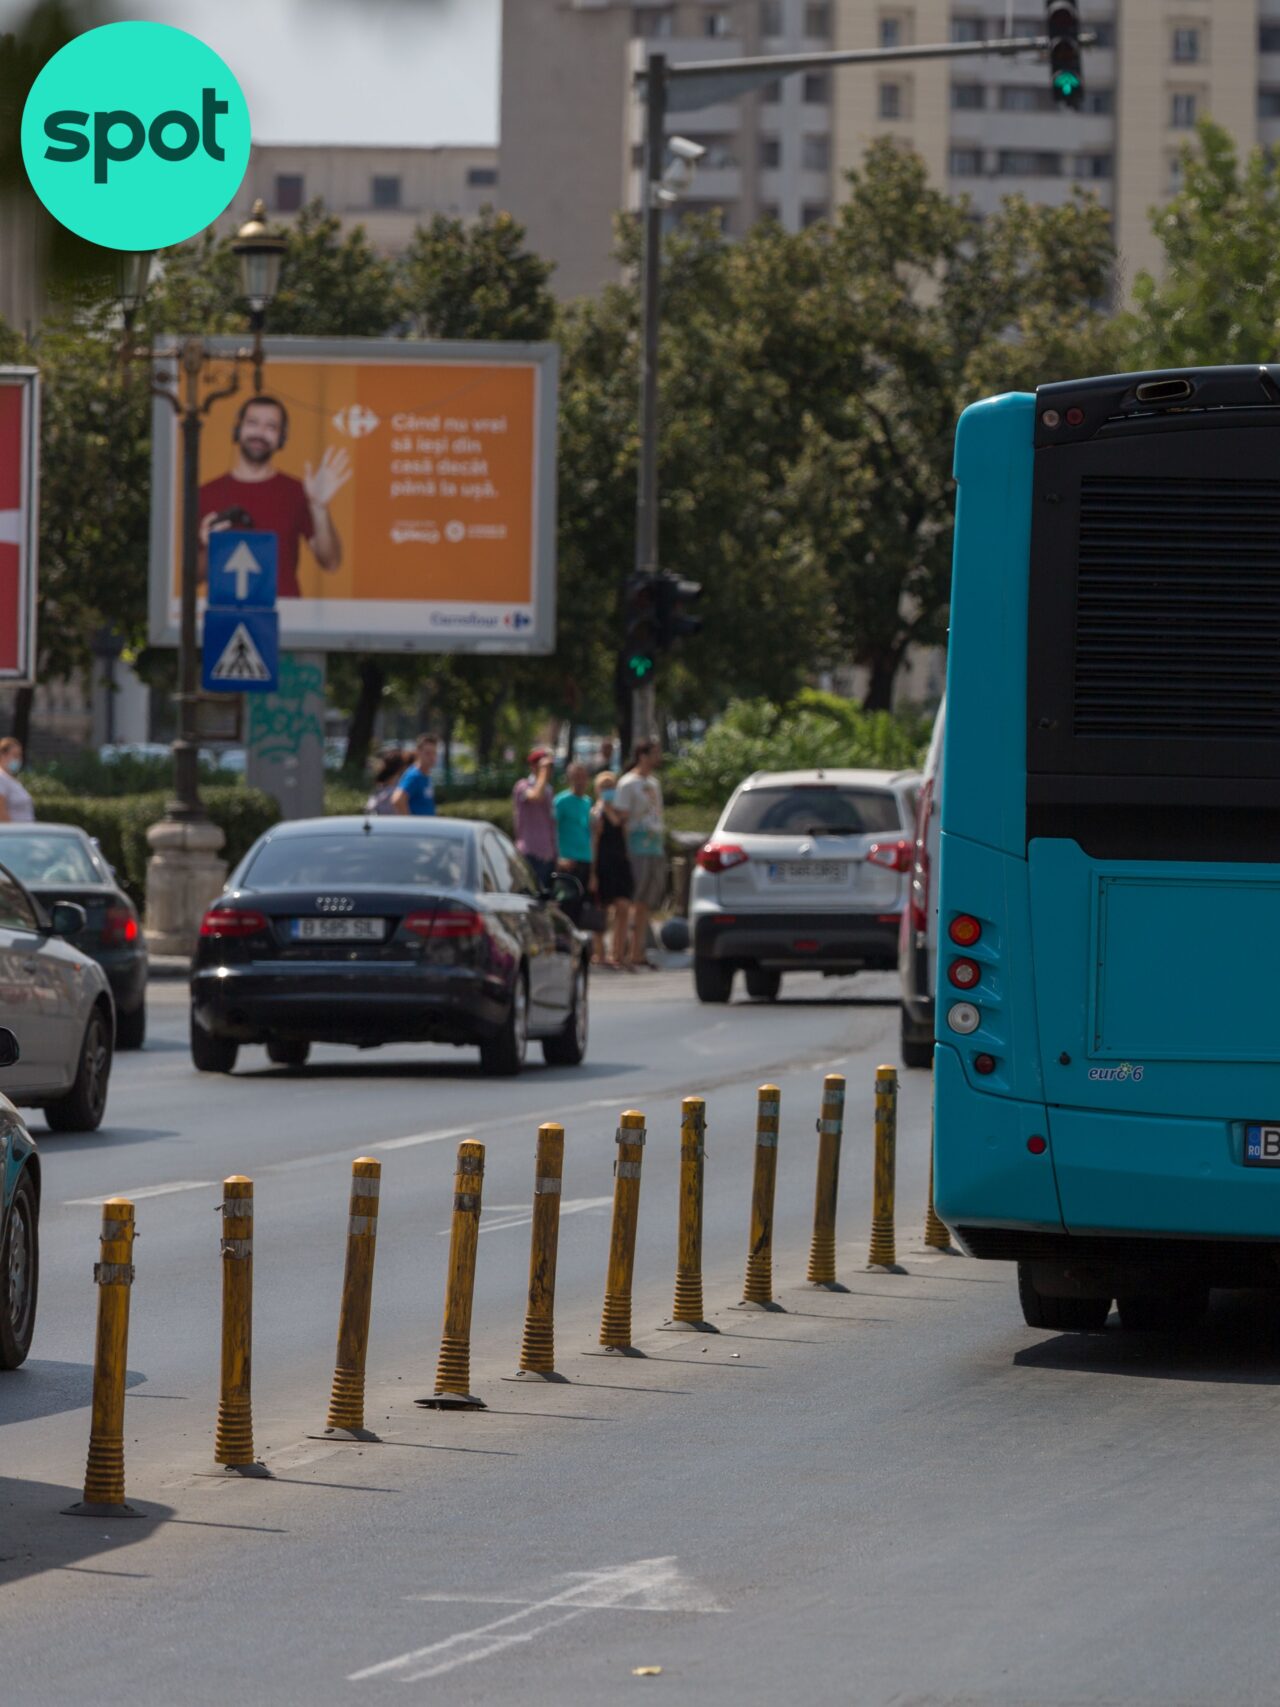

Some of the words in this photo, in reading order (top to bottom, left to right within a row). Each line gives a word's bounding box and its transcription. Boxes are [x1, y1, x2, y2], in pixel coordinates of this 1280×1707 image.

[445, 416, 469, 433] nu
[1132, 1066, 1144, 1081] 6
[1248, 1145, 1260, 1156] RO
